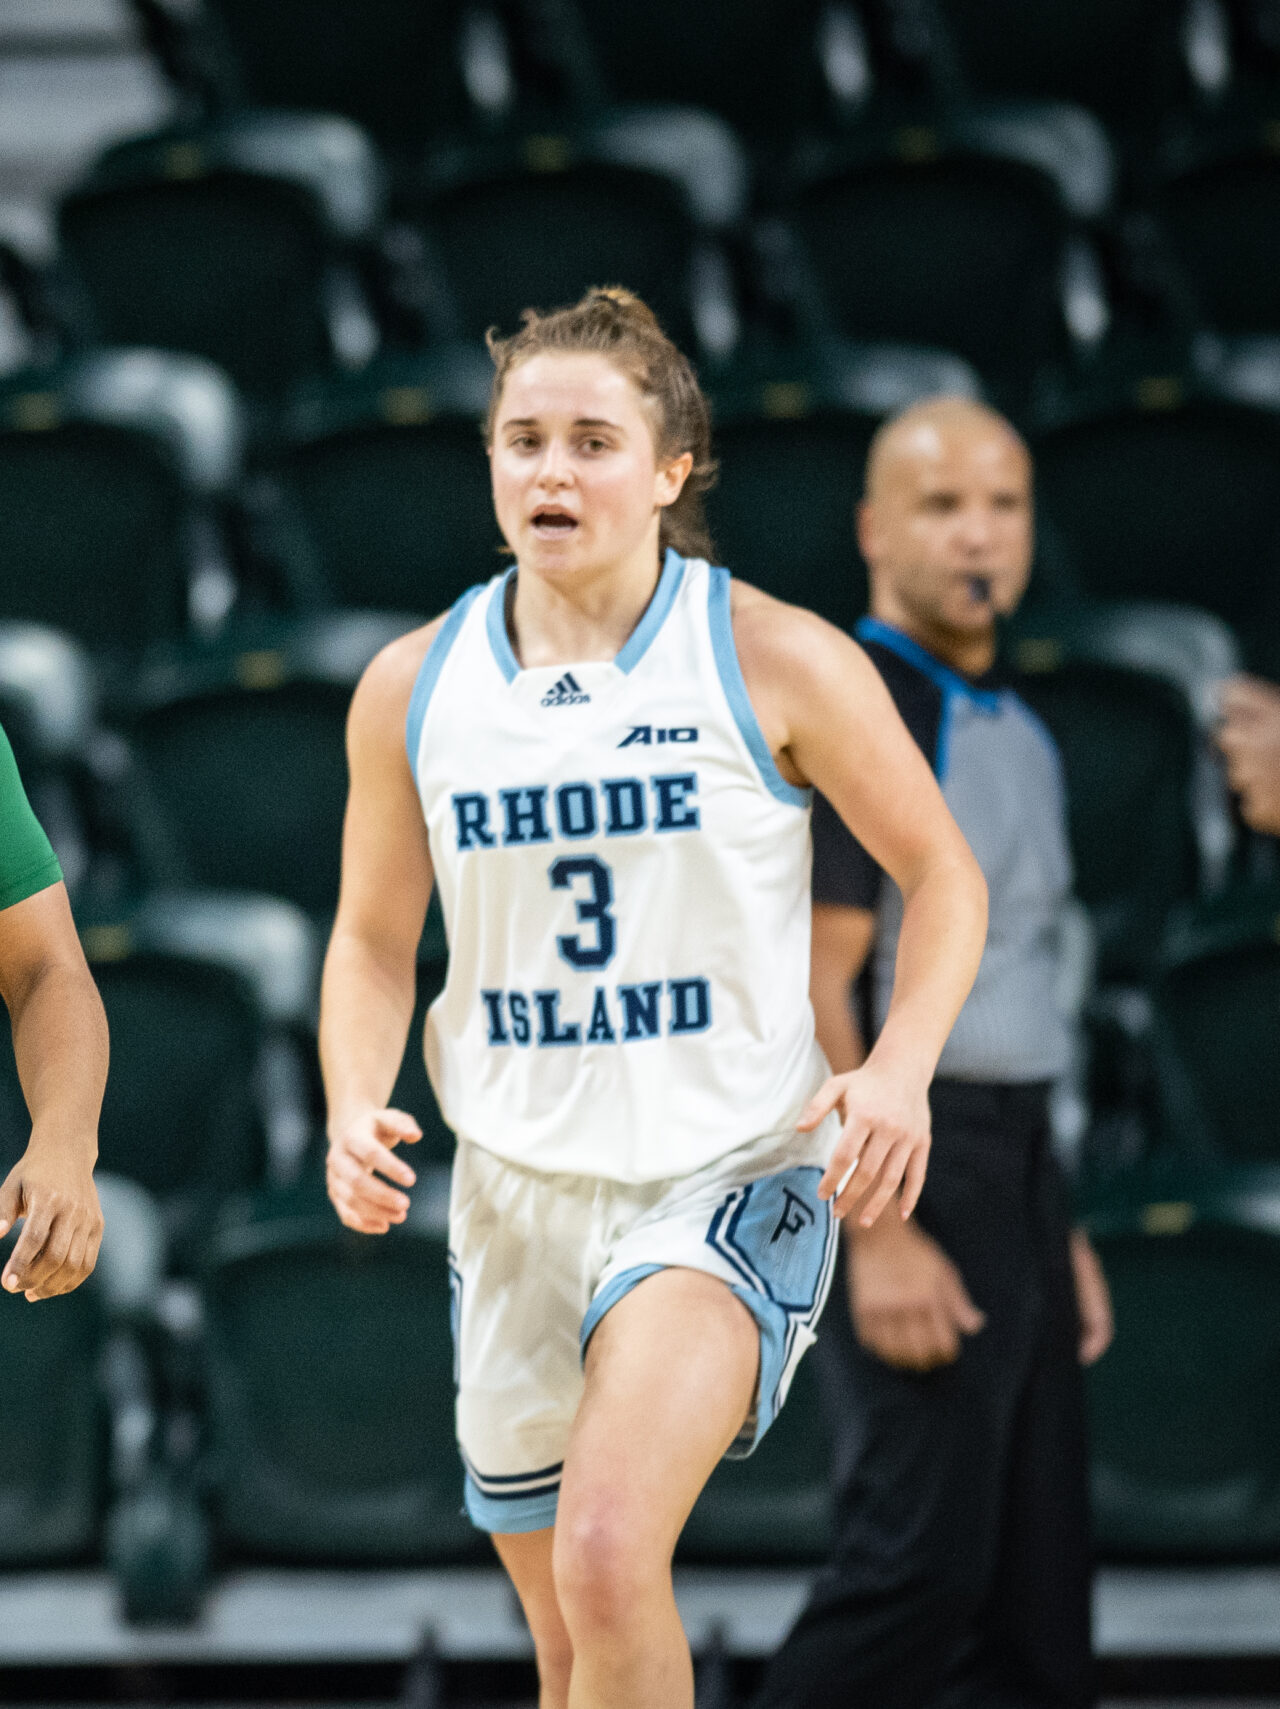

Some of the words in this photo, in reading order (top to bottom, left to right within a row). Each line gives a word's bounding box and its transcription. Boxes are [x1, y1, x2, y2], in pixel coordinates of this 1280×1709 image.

[540, 693, 592, 708] adidas
[451, 771, 701, 852] RHODE
[547, 852, 618, 973] 3
[480, 975, 713, 1049] ISLAND
